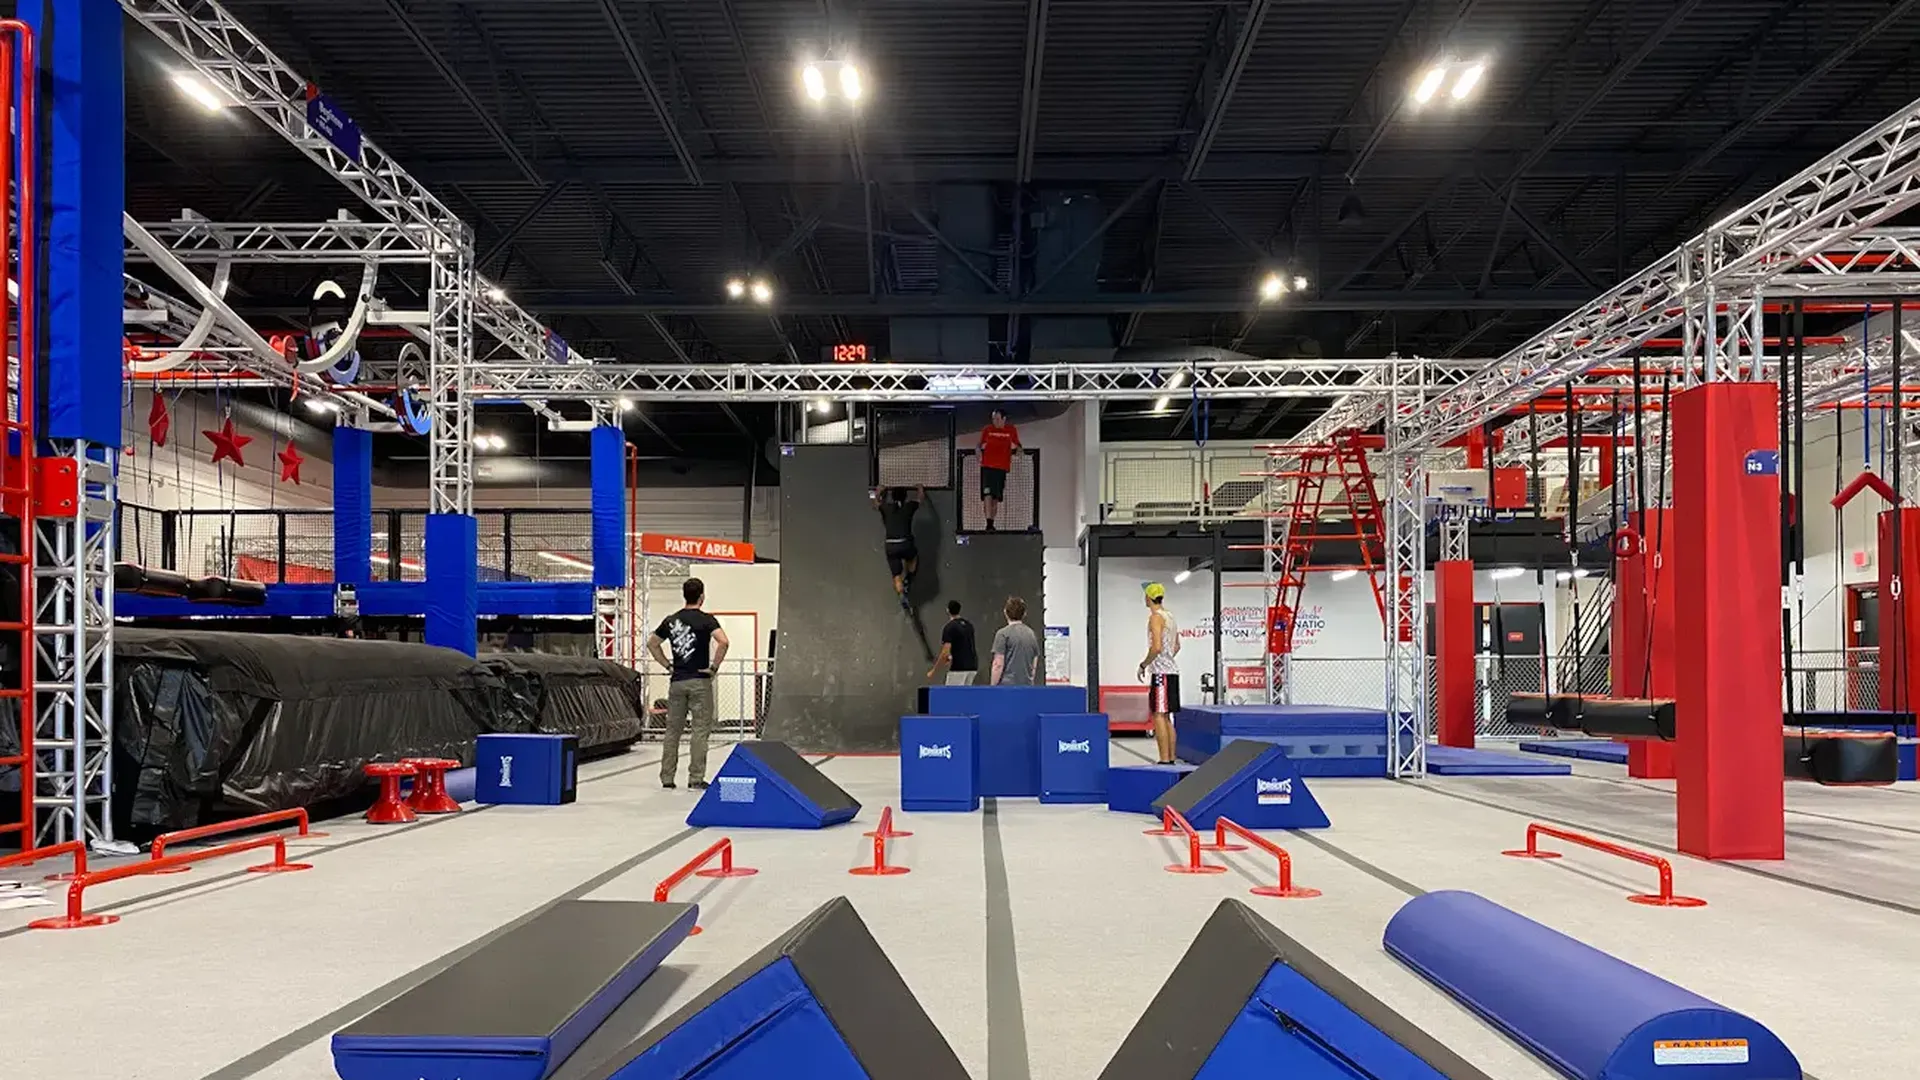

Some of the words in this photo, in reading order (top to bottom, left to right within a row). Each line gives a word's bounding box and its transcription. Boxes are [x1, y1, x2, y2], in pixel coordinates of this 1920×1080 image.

[665, 538, 703, 554] PARTY
[705, 542, 736, 558] AREA
[1232, 676, 1265, 685] SAFETY
